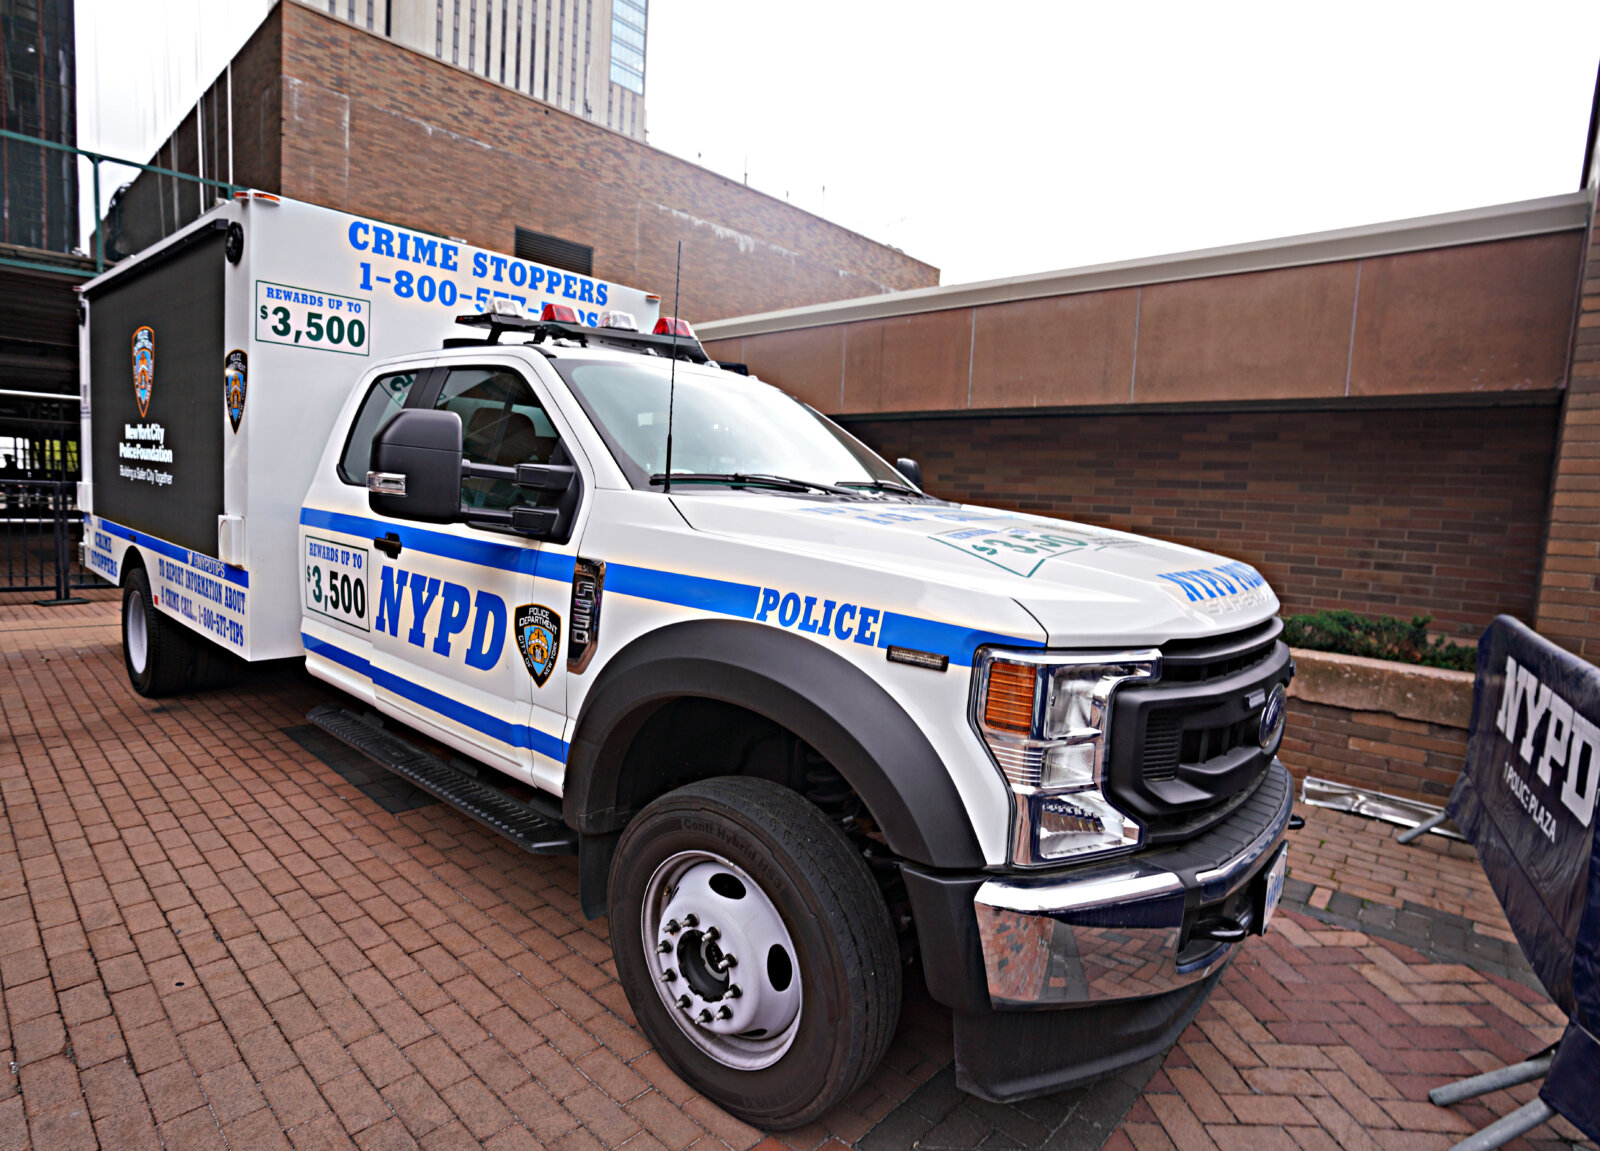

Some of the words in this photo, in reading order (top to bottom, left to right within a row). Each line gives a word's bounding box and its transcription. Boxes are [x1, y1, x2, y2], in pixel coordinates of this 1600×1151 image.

[348, 221, 459, 272] CRIME
[472, 252, 609, 306] STOPPERS
[266, 287, 324, 307] REWARDS
[328, 298, 343, 310] UP
[347, 301, 362, 314] TO
[260, 305, 366, 347] $3,500
[91, 549, 118, 577] STOPPERS
[309, 542, 339, 563] REWARDS
[341, 550, 351, 566] UP
[352, 553, 363, 569] TO
[159, 557, 165, 578] TO
[166, 560, 184, 588] REPORT
[185, 569, 223, 605] INFORMATION
[224, 585, 246, 615] ABOUT
[306, 564, 366, 619] $3,500
[1156, 569, 1238, 602] NYPD
[198, 603, 244, 648] 1-800-577-TIPS
[375, 565, 508, 672] NYPD
[519, 615, 558, 636] DEPARTMENT
[528, 606, 551, 620] POLICE
[756, 587, 881, 647] POLICE
[518, 634, 528, 655] CITY
[525, 656, 533, 668] OF
[550, 641, 558, 660] YORK
[1496, 655, 1600, 828] NYPD
[1528, 793, 1557, 844] PLAZA
[717, 826, 758, 861] Hybrid
